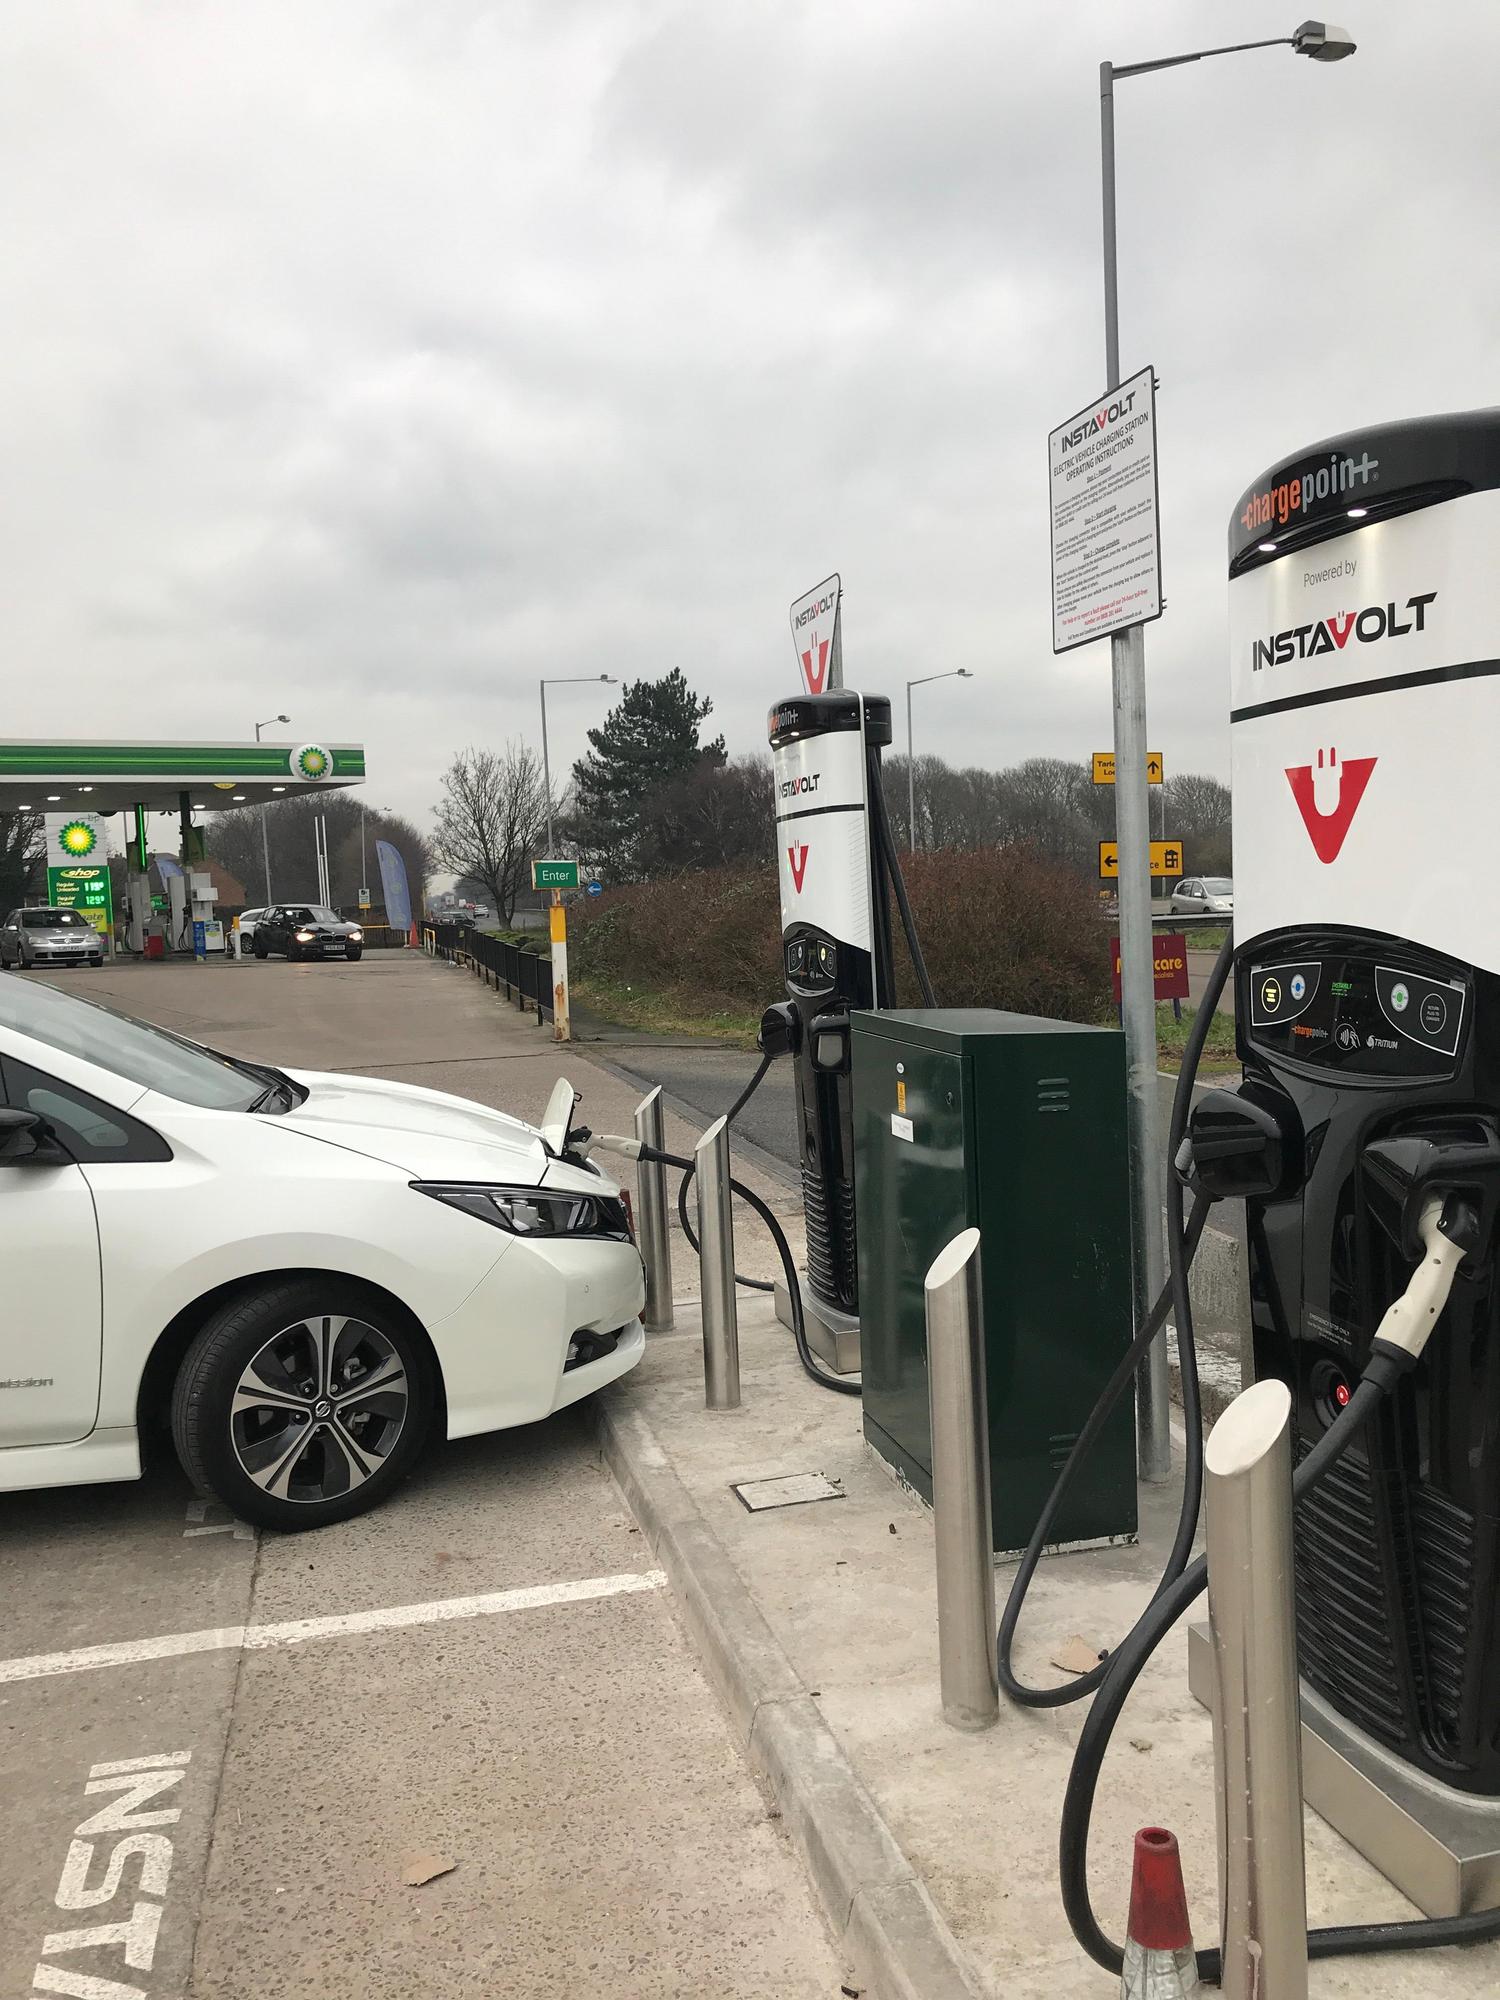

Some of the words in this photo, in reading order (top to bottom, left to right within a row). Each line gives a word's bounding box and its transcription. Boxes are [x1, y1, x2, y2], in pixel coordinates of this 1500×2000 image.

[1062, 391, 1136, 453] INSTAVOLT
[1054, 456, 1074, 477] ELECTRIC
[1075, 444, 1095, 463] VEHICLE
[1096, 426, 1124, 451] CHARGING
[1125, 411, 1148, 434] STATION
[1066, 458, 1094, 481] OPERATING
[1095, 434, 1134, 465] INSTRUCTIONS
[1304, 561, 1343, 587] Powered
[1345, 560, 1357, 576] by
[796, 592, 835, 630] INSTAVOLT
[1252, 592, 1438, 672] INSTAVOLT
[68, 868, 101, 878] shop
[542, 870, 570, 881] Enter
[1374, 1038, 1399, 1050] TRITIUM
